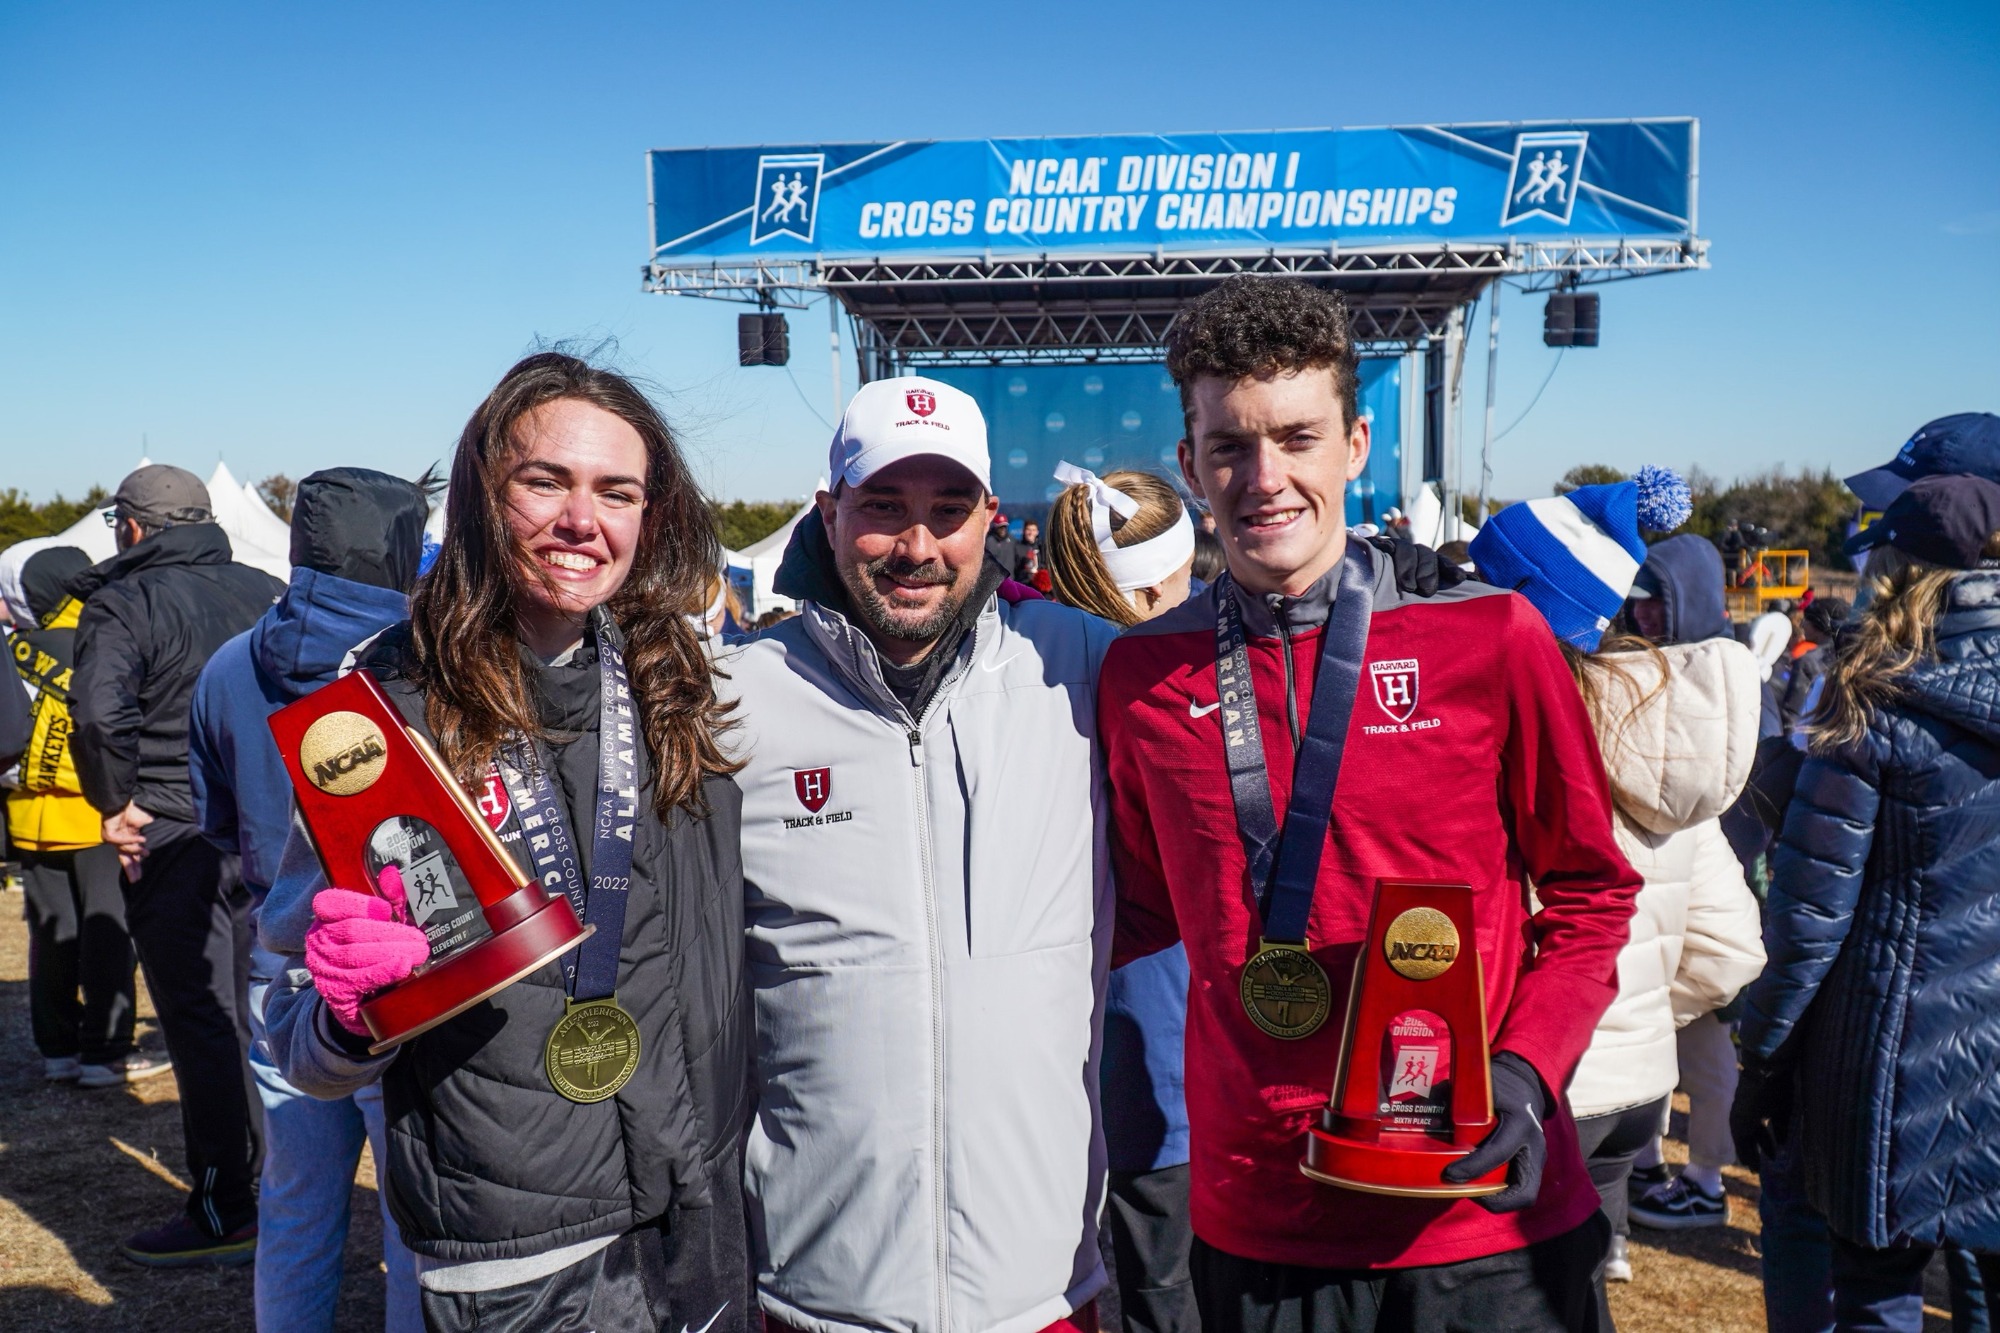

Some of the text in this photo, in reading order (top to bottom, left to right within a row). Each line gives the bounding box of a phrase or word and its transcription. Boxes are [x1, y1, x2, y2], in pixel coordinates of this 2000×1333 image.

[1009, 152, 1300, 196] NCAA DIVISION I
[859, 186, 1458, 238] CROSS COUNTRY CHAMPIONSHIPS
[912, 395, 931, 411] H
[895, 419, 920, 428] TRACK
[931, 421, 950, 431] FIELD
[1372, 661, 1416, 671] HARVARD
[604, 671, 614, 715] CROSS
[1382, 674, 1411, 706] H
[1240, 680, 1258, 741] COUNTRY
[1363, 718, 1441, 734] TRACK & FIELD
[313, 734, 386, 787] NCAA
[603, 729, 615, 793] DIVISION
[804, 773, 823, 800] H
[545, 807, 569, 853] CROSS
[600, 799, 614, 840] NCAA
[783, 811, 852, 829] TRACK & FIELD
[380, 833, 426, 865] DIVISION
[386, 826, 415, 849] 2022
[593, 876, 629, 890] 2022
[426, 922, 450, 943] CROSS
[431, 933, 463, 955] ELEVENTH
[1390, 941, 1455, 962] NCAA
[560, 1007, 629, 1038] ALL-AMERICAN
[1391, 1104, 1413, 1113] CROSS
[1414, 1105, 1445, 1114] COUNTRY
[1394, 1116, 1432, 1126] SIXTH PLACE
